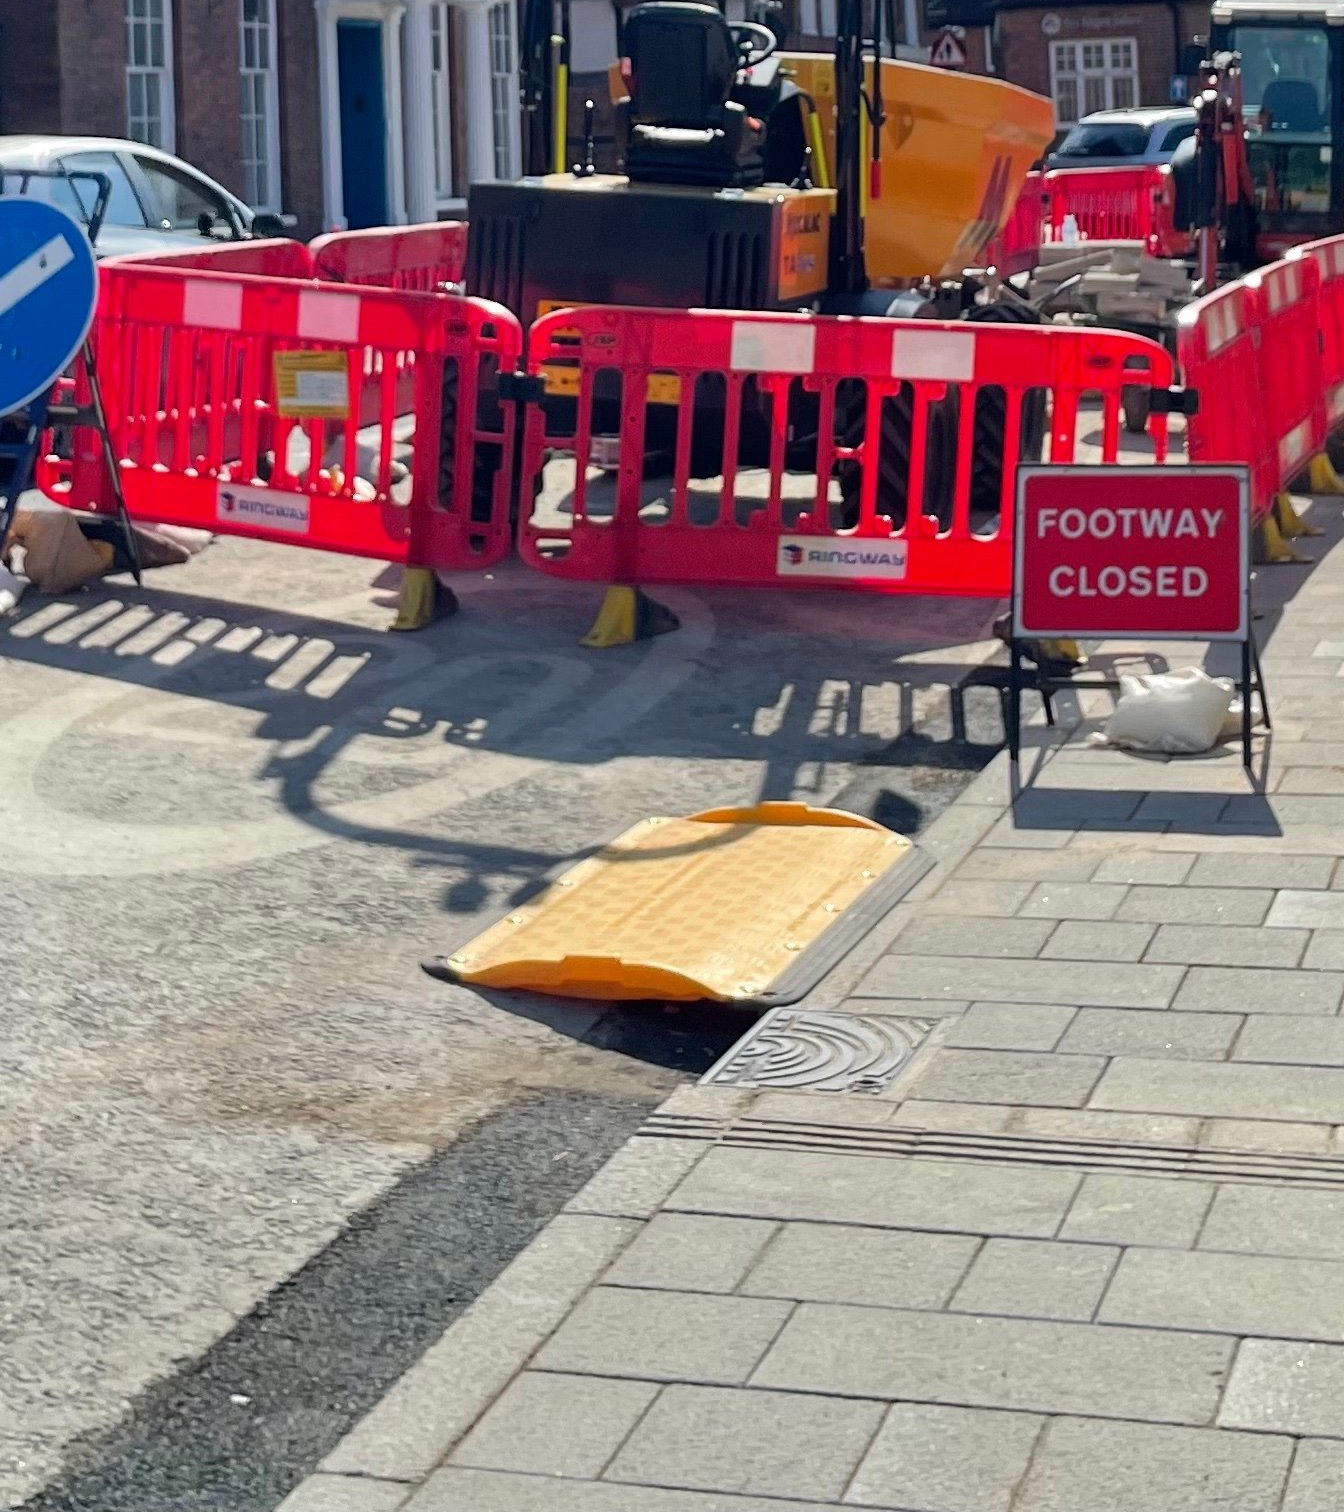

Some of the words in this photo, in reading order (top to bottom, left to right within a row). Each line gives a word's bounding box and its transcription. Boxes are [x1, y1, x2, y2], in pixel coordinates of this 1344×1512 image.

[1037, 507, 1224, 539] FOOTWAY
[807, 550, 905, 567] RINGWAY
[1048, 565, 1209, 598] CLOSED
